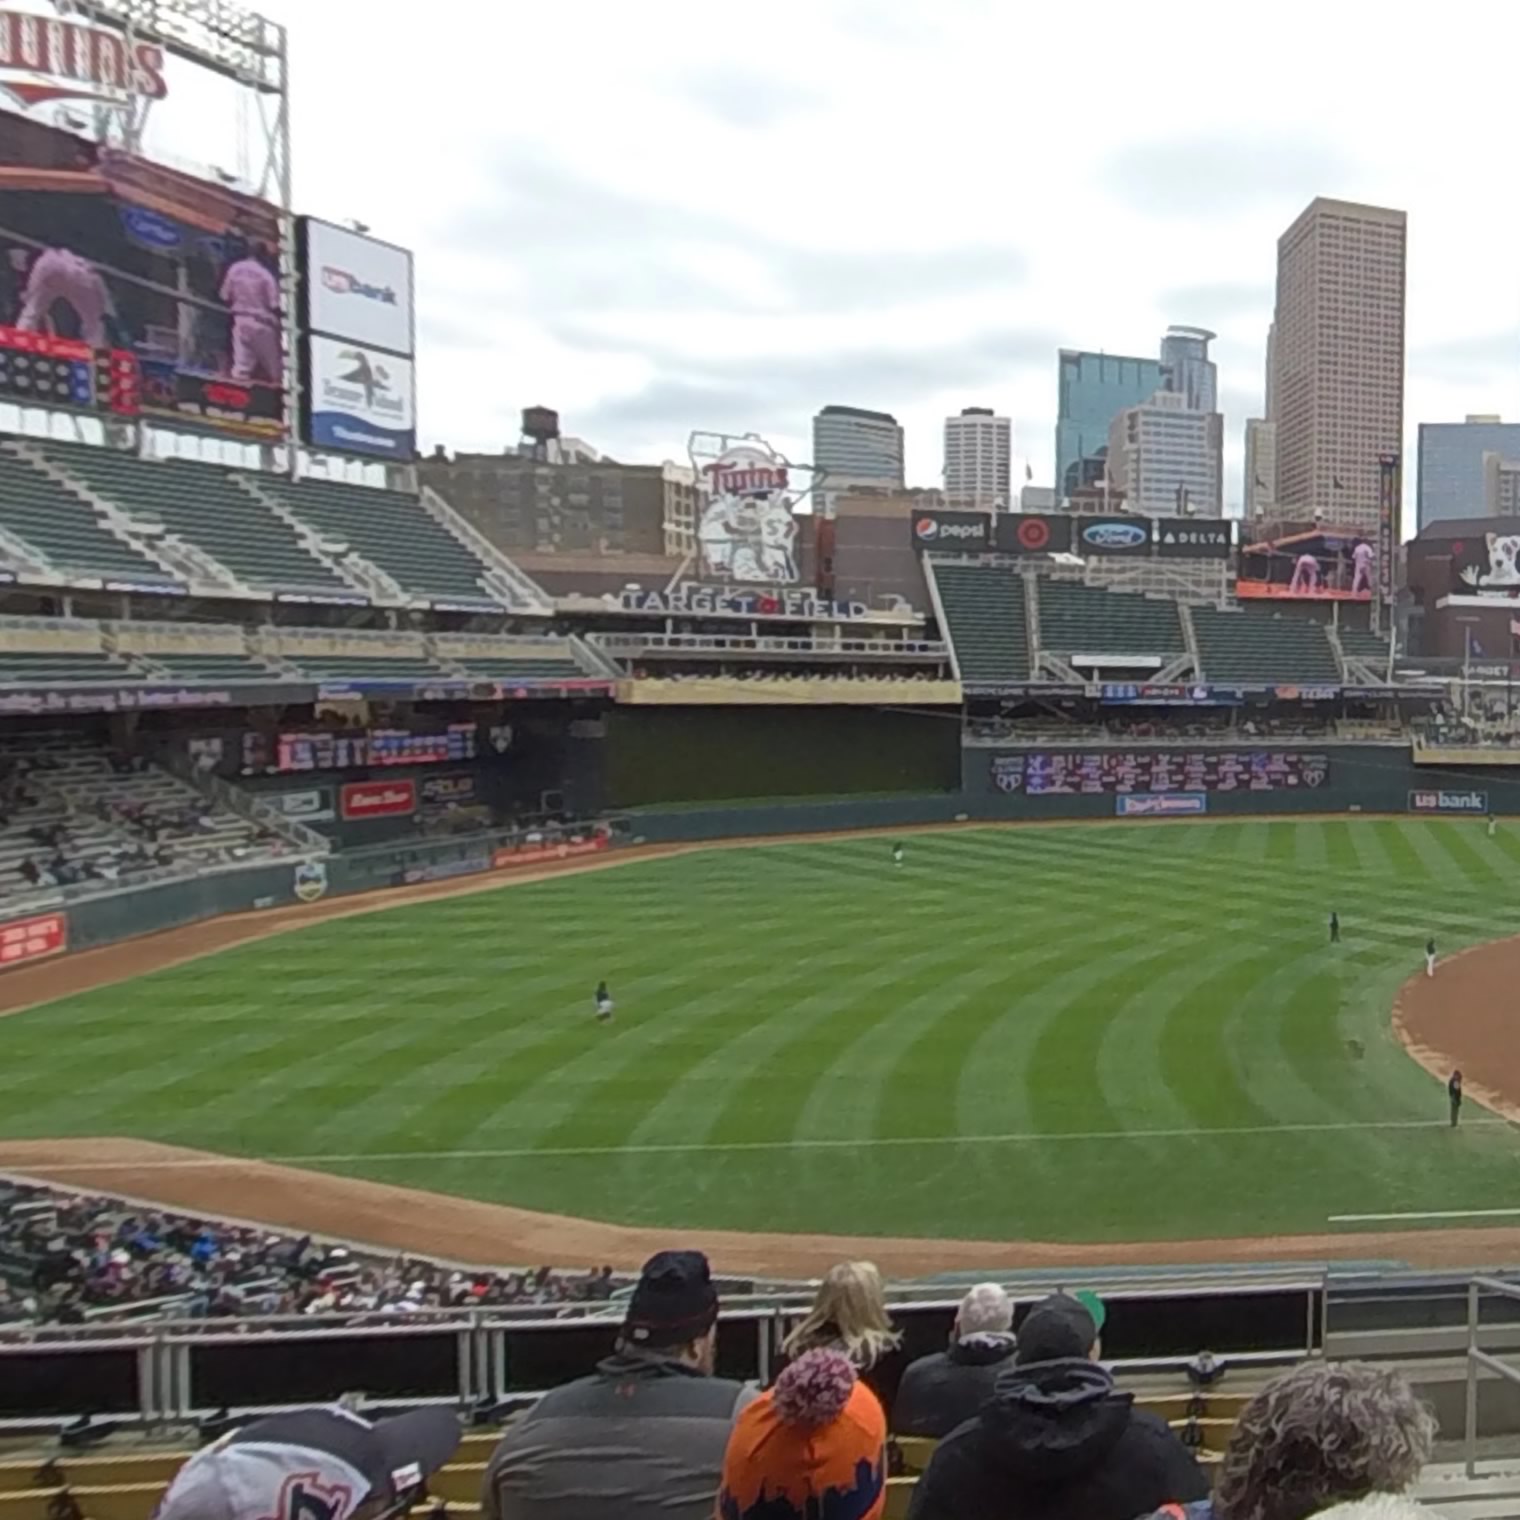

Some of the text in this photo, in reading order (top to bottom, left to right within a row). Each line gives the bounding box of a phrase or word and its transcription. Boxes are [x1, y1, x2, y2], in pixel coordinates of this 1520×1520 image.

[702, 461, 789, 497] Twins
[940, 523, 984, 539] pepsi
[1179, 532, 1226, 544] DELTA
[623, 590, 868, 619] TARGET FIELD
